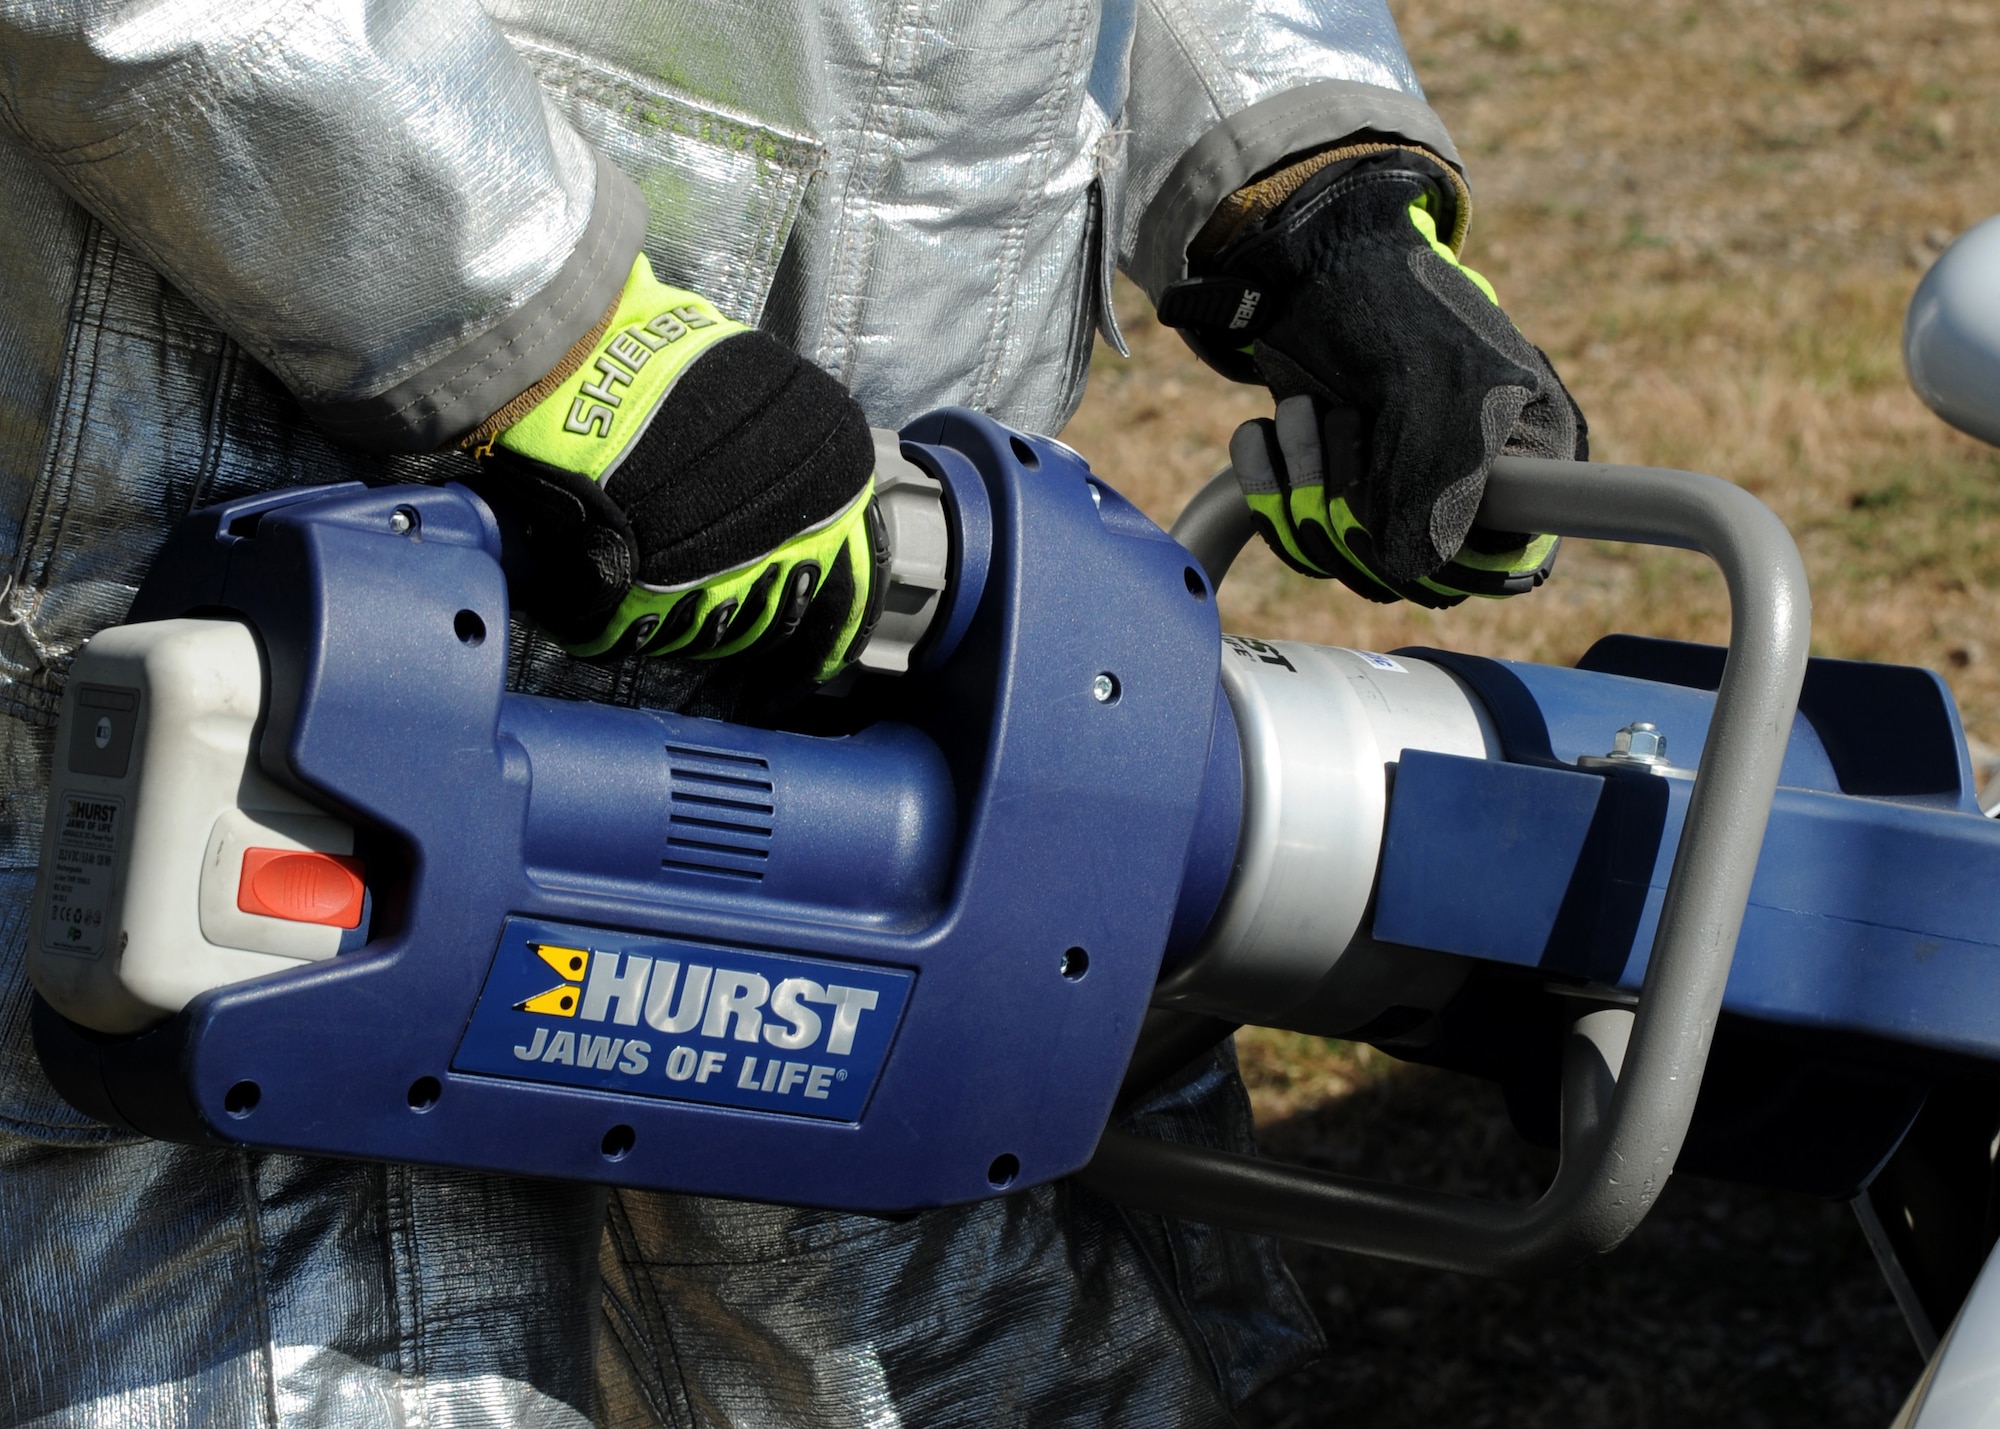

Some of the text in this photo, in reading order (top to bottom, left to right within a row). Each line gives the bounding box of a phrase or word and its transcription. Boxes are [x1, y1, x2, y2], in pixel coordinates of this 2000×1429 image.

[1229, 289, 1261, 329] SHELB
[563, 305, 717, 438] SHELBY
[66, 818, 85, 829] JAWS
[87, 821, 96, 830] OF
[76, 801, 117, 822] HURST
[580, 950, 879, 1055] HURST
[513, 1028, 651, 1075] JAWS
[665, 1046, 727, 1083] OF
